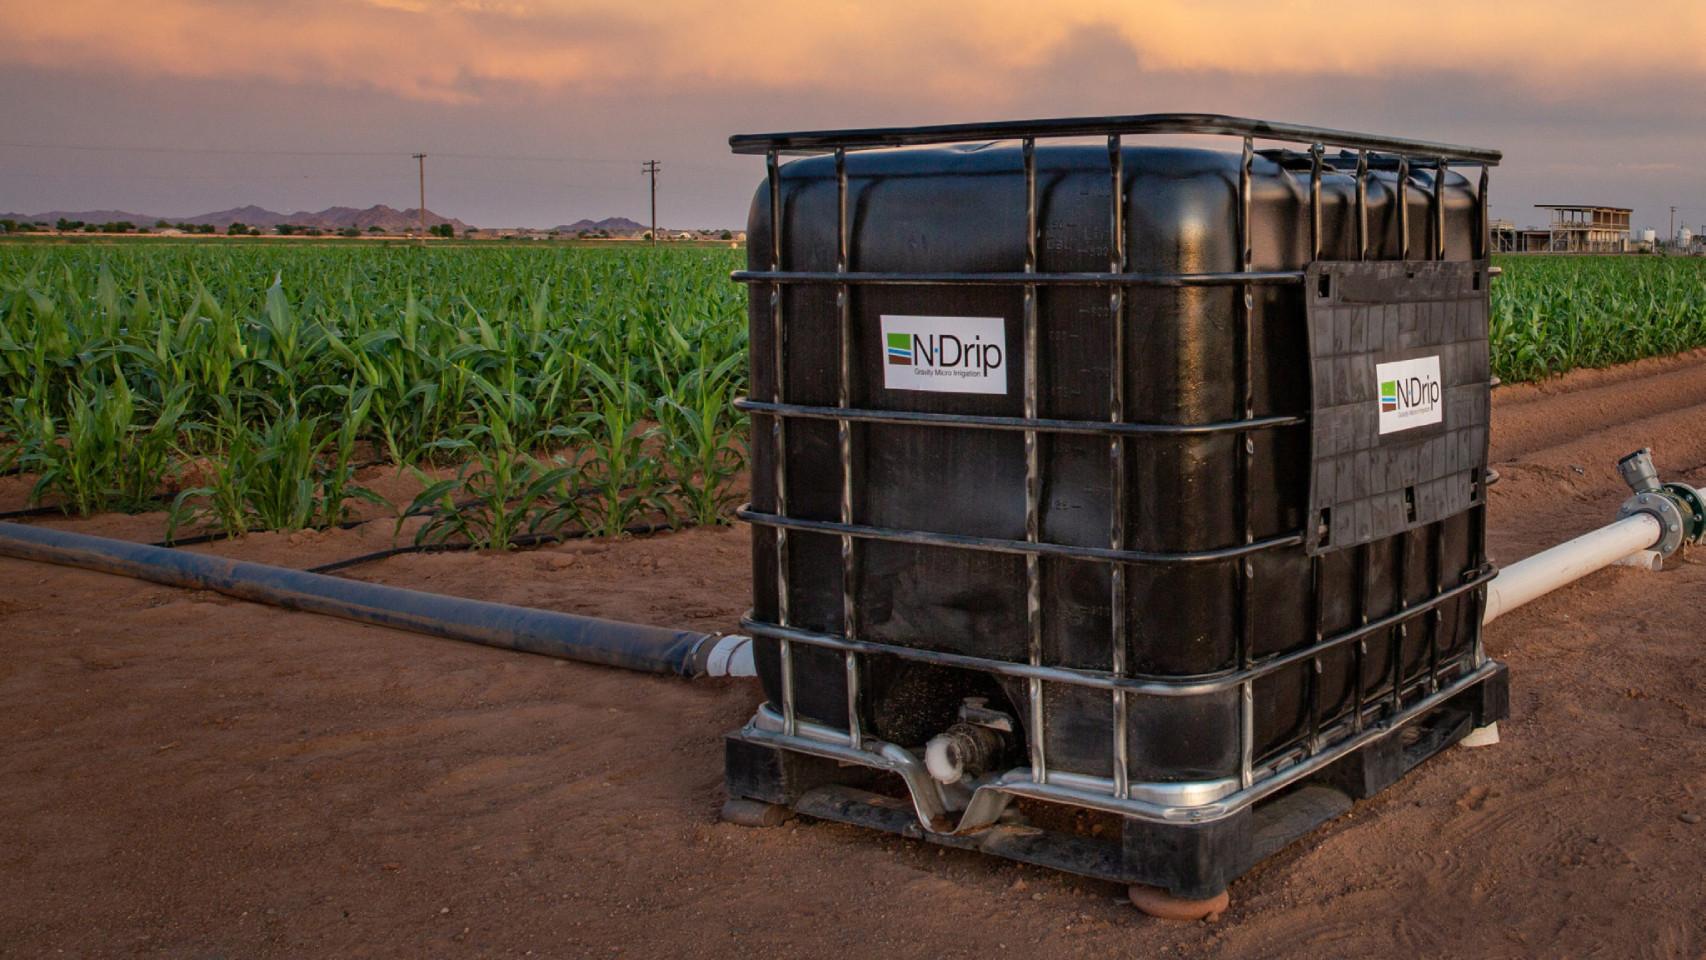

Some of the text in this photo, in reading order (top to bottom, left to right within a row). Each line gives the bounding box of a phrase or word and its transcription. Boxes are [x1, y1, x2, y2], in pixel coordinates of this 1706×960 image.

[914, 368, 981, 379] Gravity Micro Irrigation
